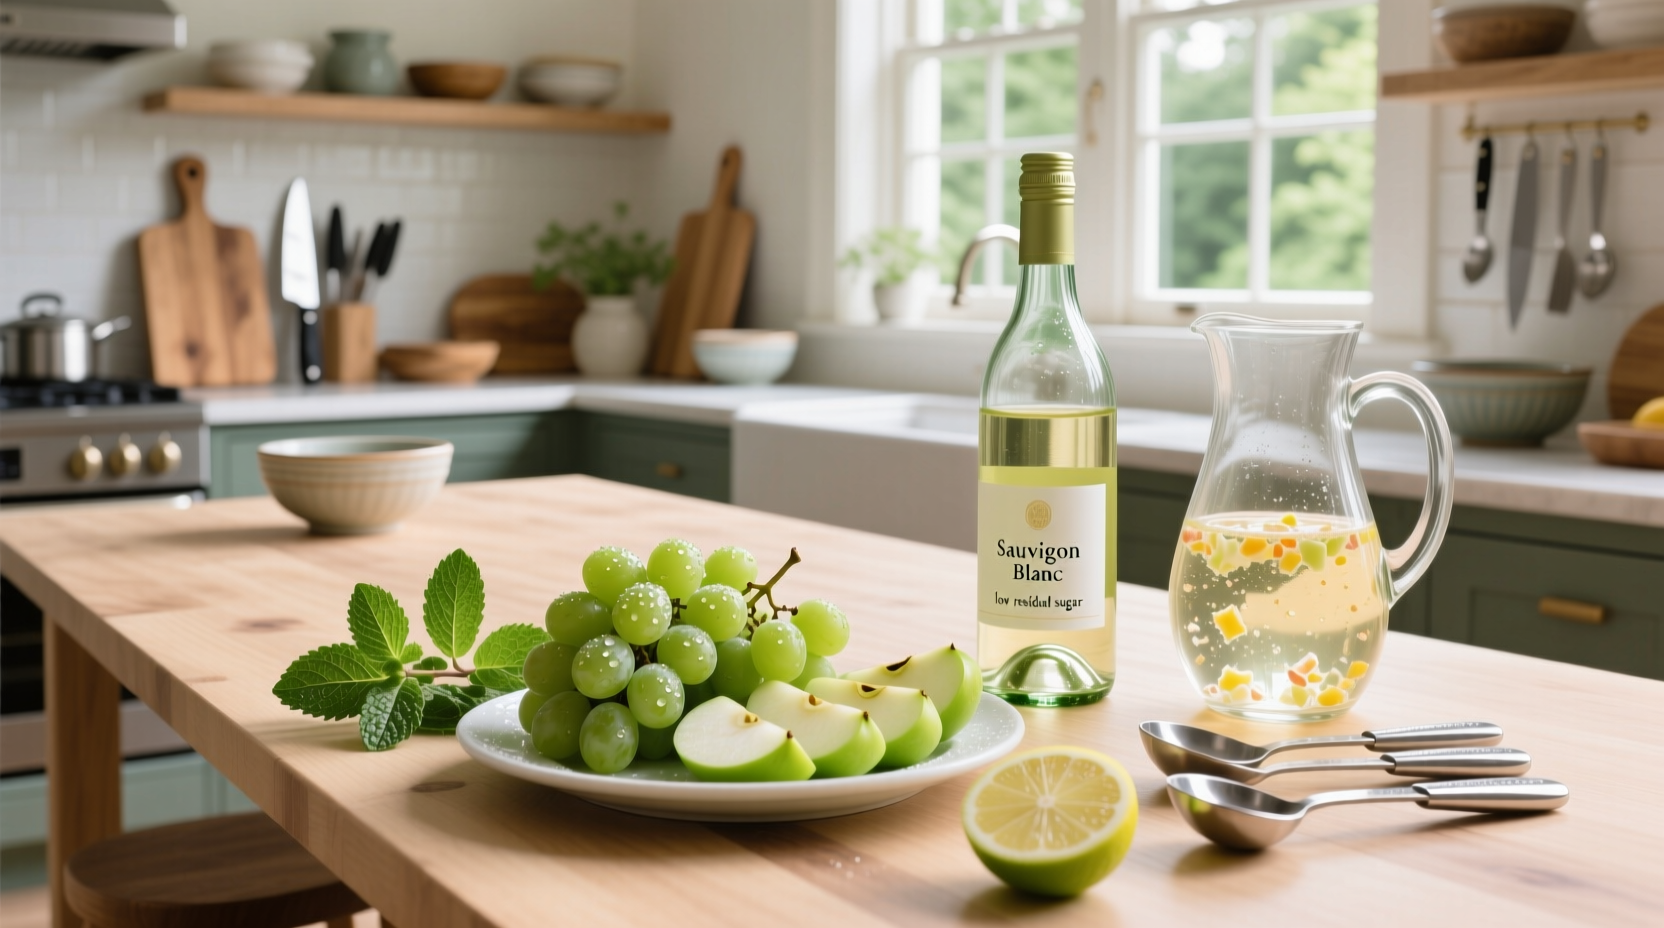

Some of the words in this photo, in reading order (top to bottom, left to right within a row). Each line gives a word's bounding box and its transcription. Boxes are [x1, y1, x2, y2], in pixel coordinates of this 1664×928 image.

[997, 539, 1080, 564] Sauvigon
[1013, 564, 1063, 582] Blanc
[1054, 599, 1083, 611] sugar
